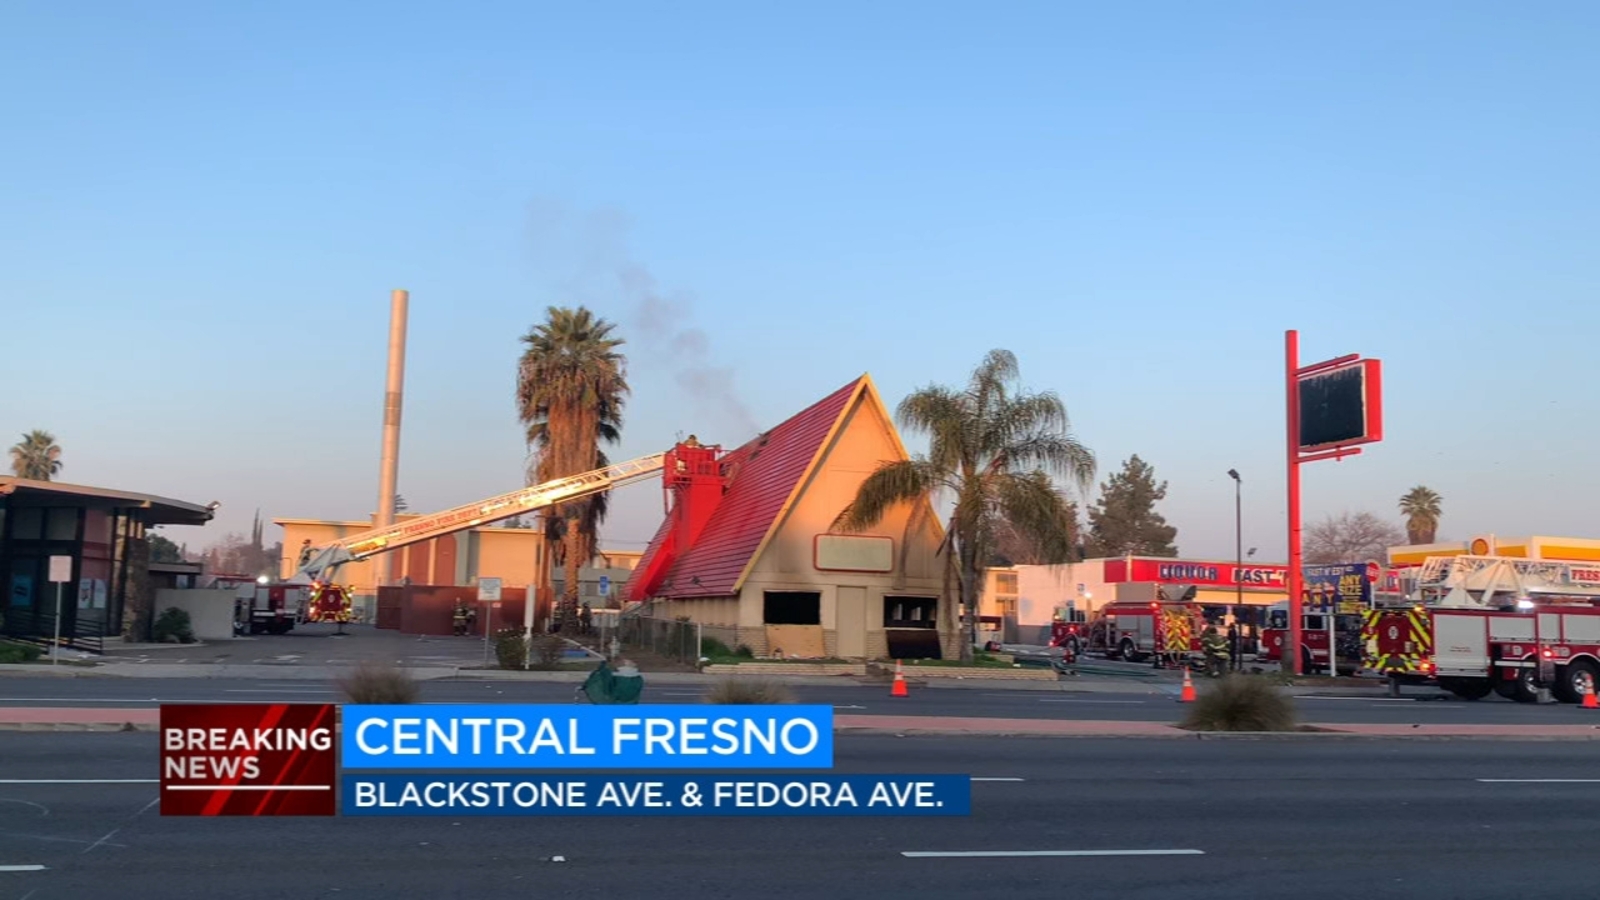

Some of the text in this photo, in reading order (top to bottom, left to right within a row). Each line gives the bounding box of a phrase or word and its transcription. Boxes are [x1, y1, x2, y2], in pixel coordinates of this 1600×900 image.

[404, 519, 435, 533] FRESNO
[437, 513, 456, 526] FIRE
[1159, 564, 1217, 580] LIQUOR
[1340, 575, 1362, 586] ANY
[1338, 585, 1363, 596] SIZE
